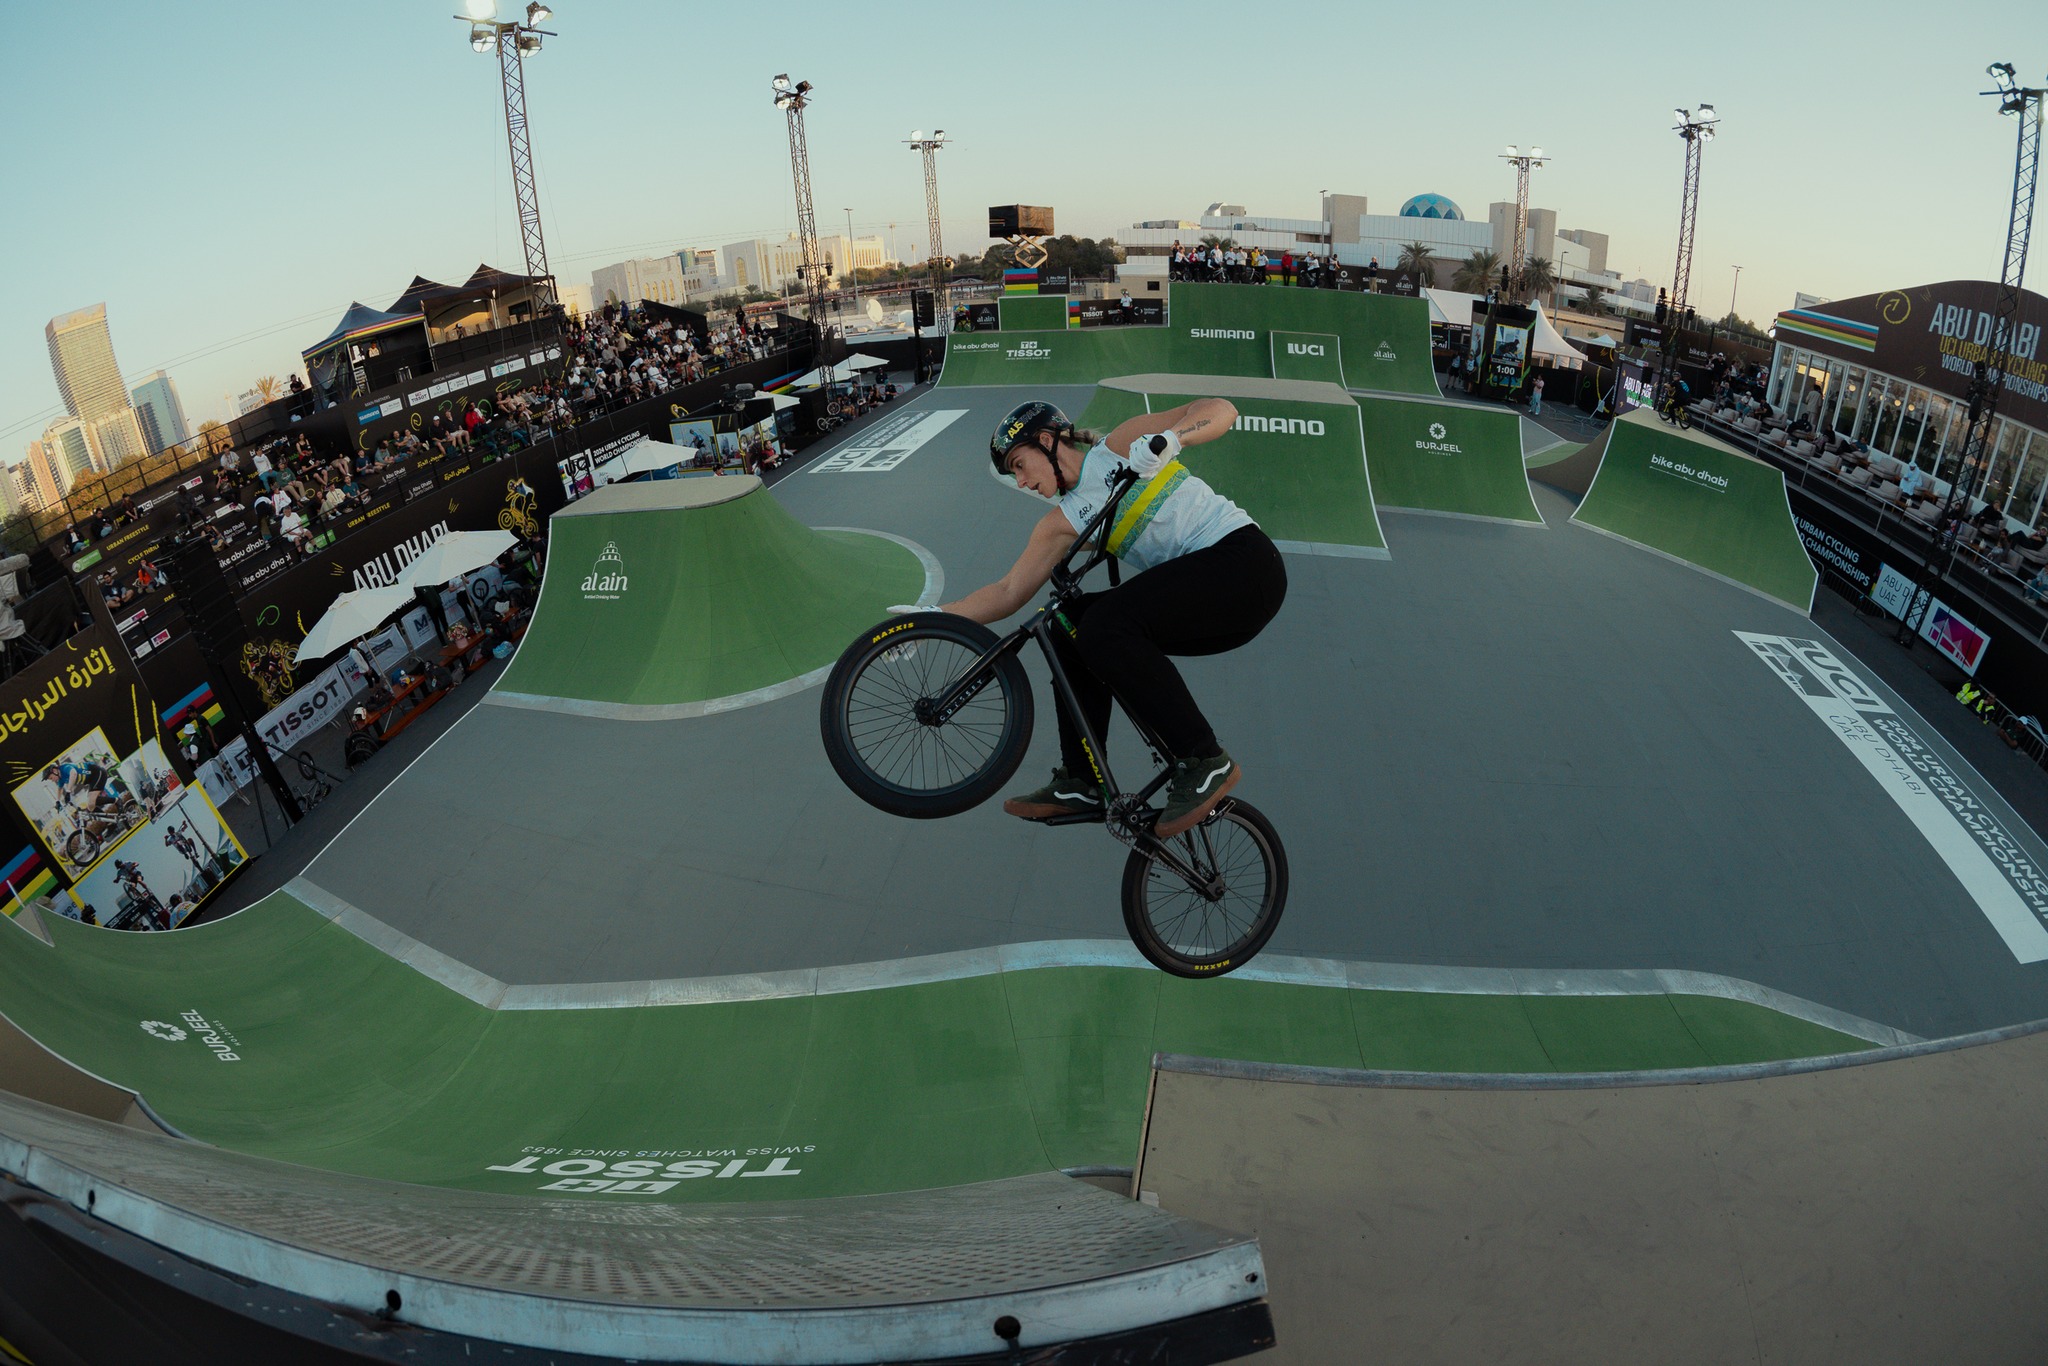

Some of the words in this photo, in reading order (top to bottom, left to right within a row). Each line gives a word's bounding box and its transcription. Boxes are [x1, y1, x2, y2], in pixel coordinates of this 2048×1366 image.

[1928, 302, 1972, 340] ABU
[1190, 328, 1255, 340] SHIMANO
[967, 342, 980, 350] abu
[980, 341, 999, 349] dhabi
[1006, 349, 1051, 357] TISSOT
[1295, 344, 1324, 356] UCI
[1381, 351, 1396, 360] ain
[1939, 335, 1957, 356] UCI
[2006, 353, 2048, 384] YCLING
[1941, 353, 1974, 377] WORLD
[1496, 364, 1516, 376] 1:00
[1230, 415, 1325, 437] IMANO
[1415, 440, 1462, 453] BURJEEL
[594, 451, 613, 465] WORLD
[824, 449, 872, 468] UCI
[1651, 453, 1674, 469] bike
[1673, 463, 1696, 476] abu
[1696, 470, 1729, 488] dhabi
[123, 524, 150, 543] FREESTYLE
[1798, 518, 1825, 542] URBAN
[1824, 534, 1860, 564] CYCLING
[231, 549, 246, 562] abu
[1805, 537, 1871, 587] CHAMPIONSHIPS
[254, 566, 270, 579] abu
[352, 551, 396, 591] ABU
[581, 572, 598, 591] al
[598, 572, 628, 591] ain
[1883, 574, 1903, 593] ABU
[1878, 586, 1898, 606] UAE
[871, 621, 915, 644] MAXXIS
[66, 645, 117, 690] إثارة
[1803, 650, 1880, 706] UCI
[265, 679, 342, 745] TISSOT
[1829, 715, 1862, 742] UAE
[1843, 715, 1878, 744] ABU
[1874, 747, 1927, 795] DHABI
[1873, 718, 1930, 773] WORLD
[1886, 719, 1924, 752] 2024
[1922, 754, 1980, 810] URBAN
[1194, 959, 1231, 971] MAXXIS
[179, 1008, 241, 1061] BURJEEL
[521, 1145, 564, 1156] 1853
[568, 1148, 630, 1158] SINCE
[635, 1148, 737, 1158] WATCHES
[745, 1144, 817, 1157] SWISS
[484, 1155, 802, 1179] TISSOT
